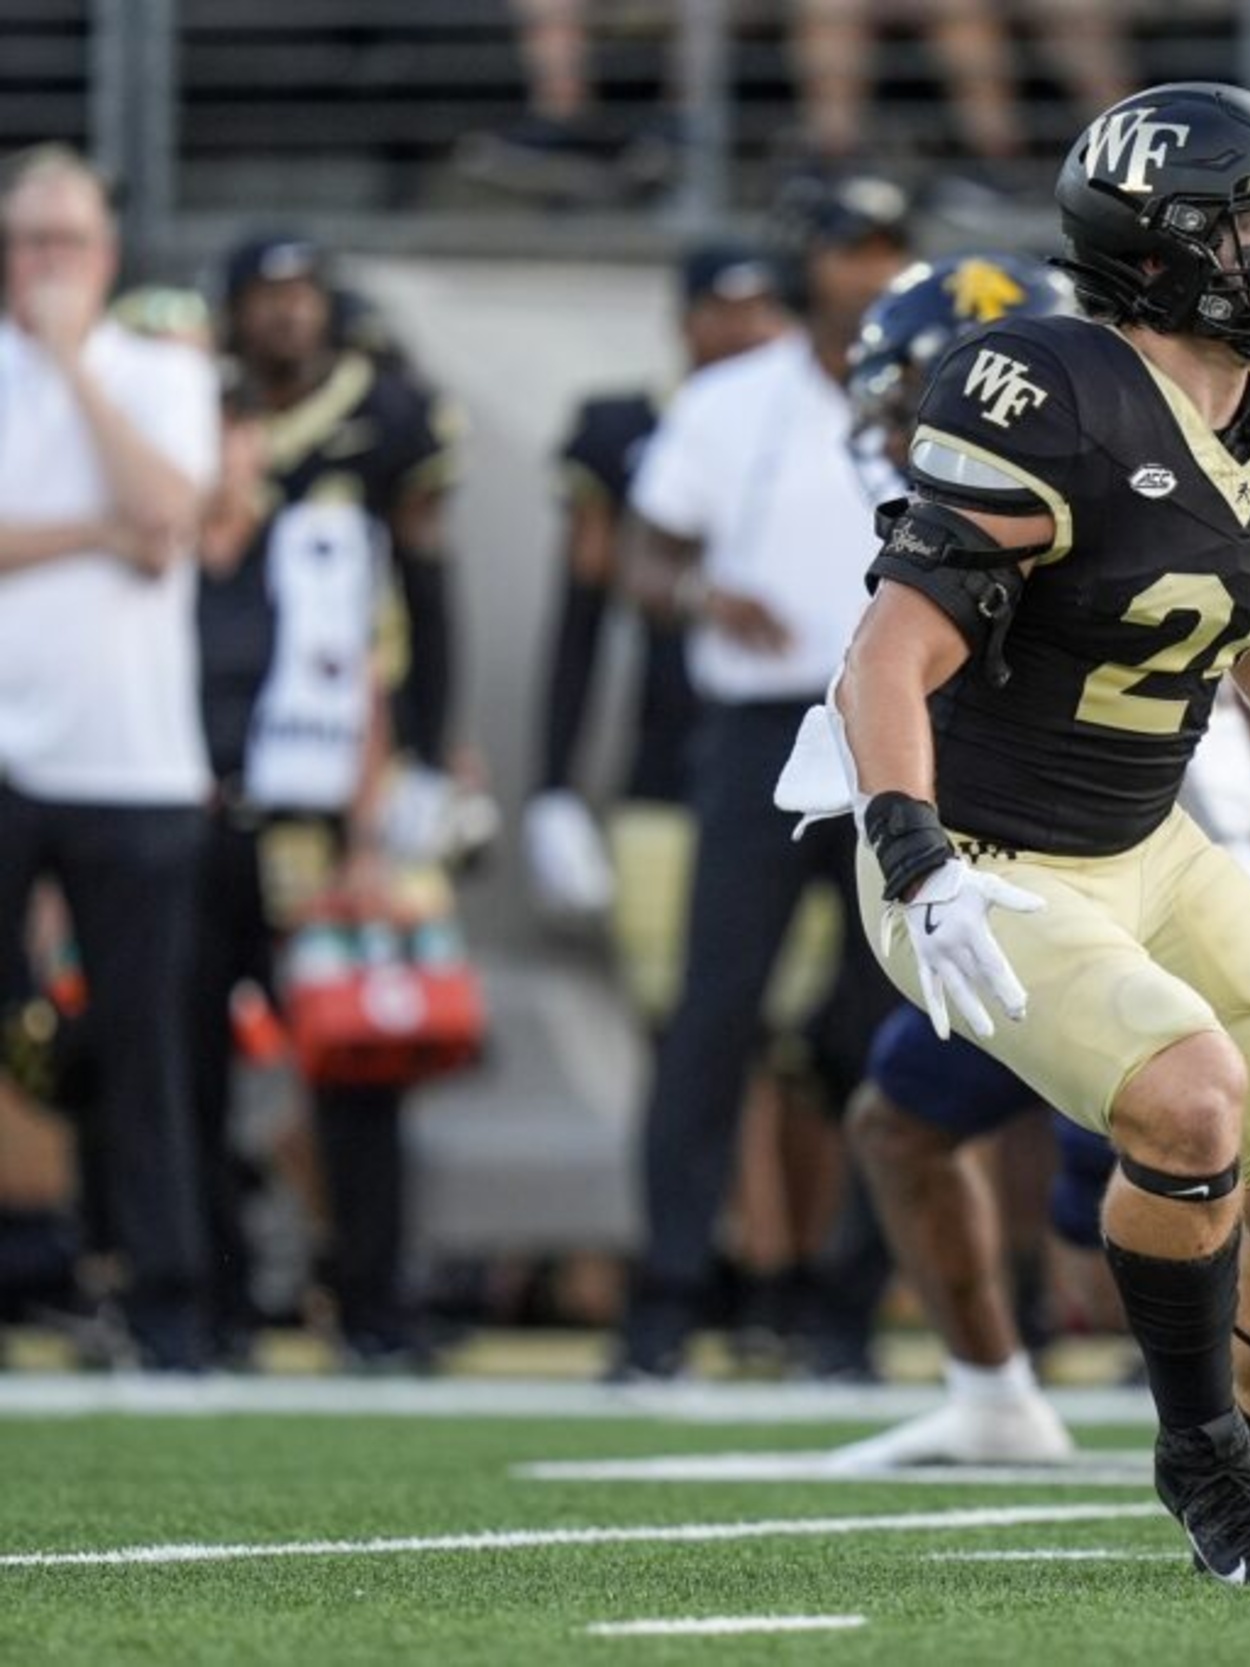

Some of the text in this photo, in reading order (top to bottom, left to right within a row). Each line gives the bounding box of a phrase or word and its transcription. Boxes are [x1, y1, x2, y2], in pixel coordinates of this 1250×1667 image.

[1085, 107, 1190, 192] WF
[963, 348, 1048, 428] WF
[1132, 471, 1172, 491] ACC
